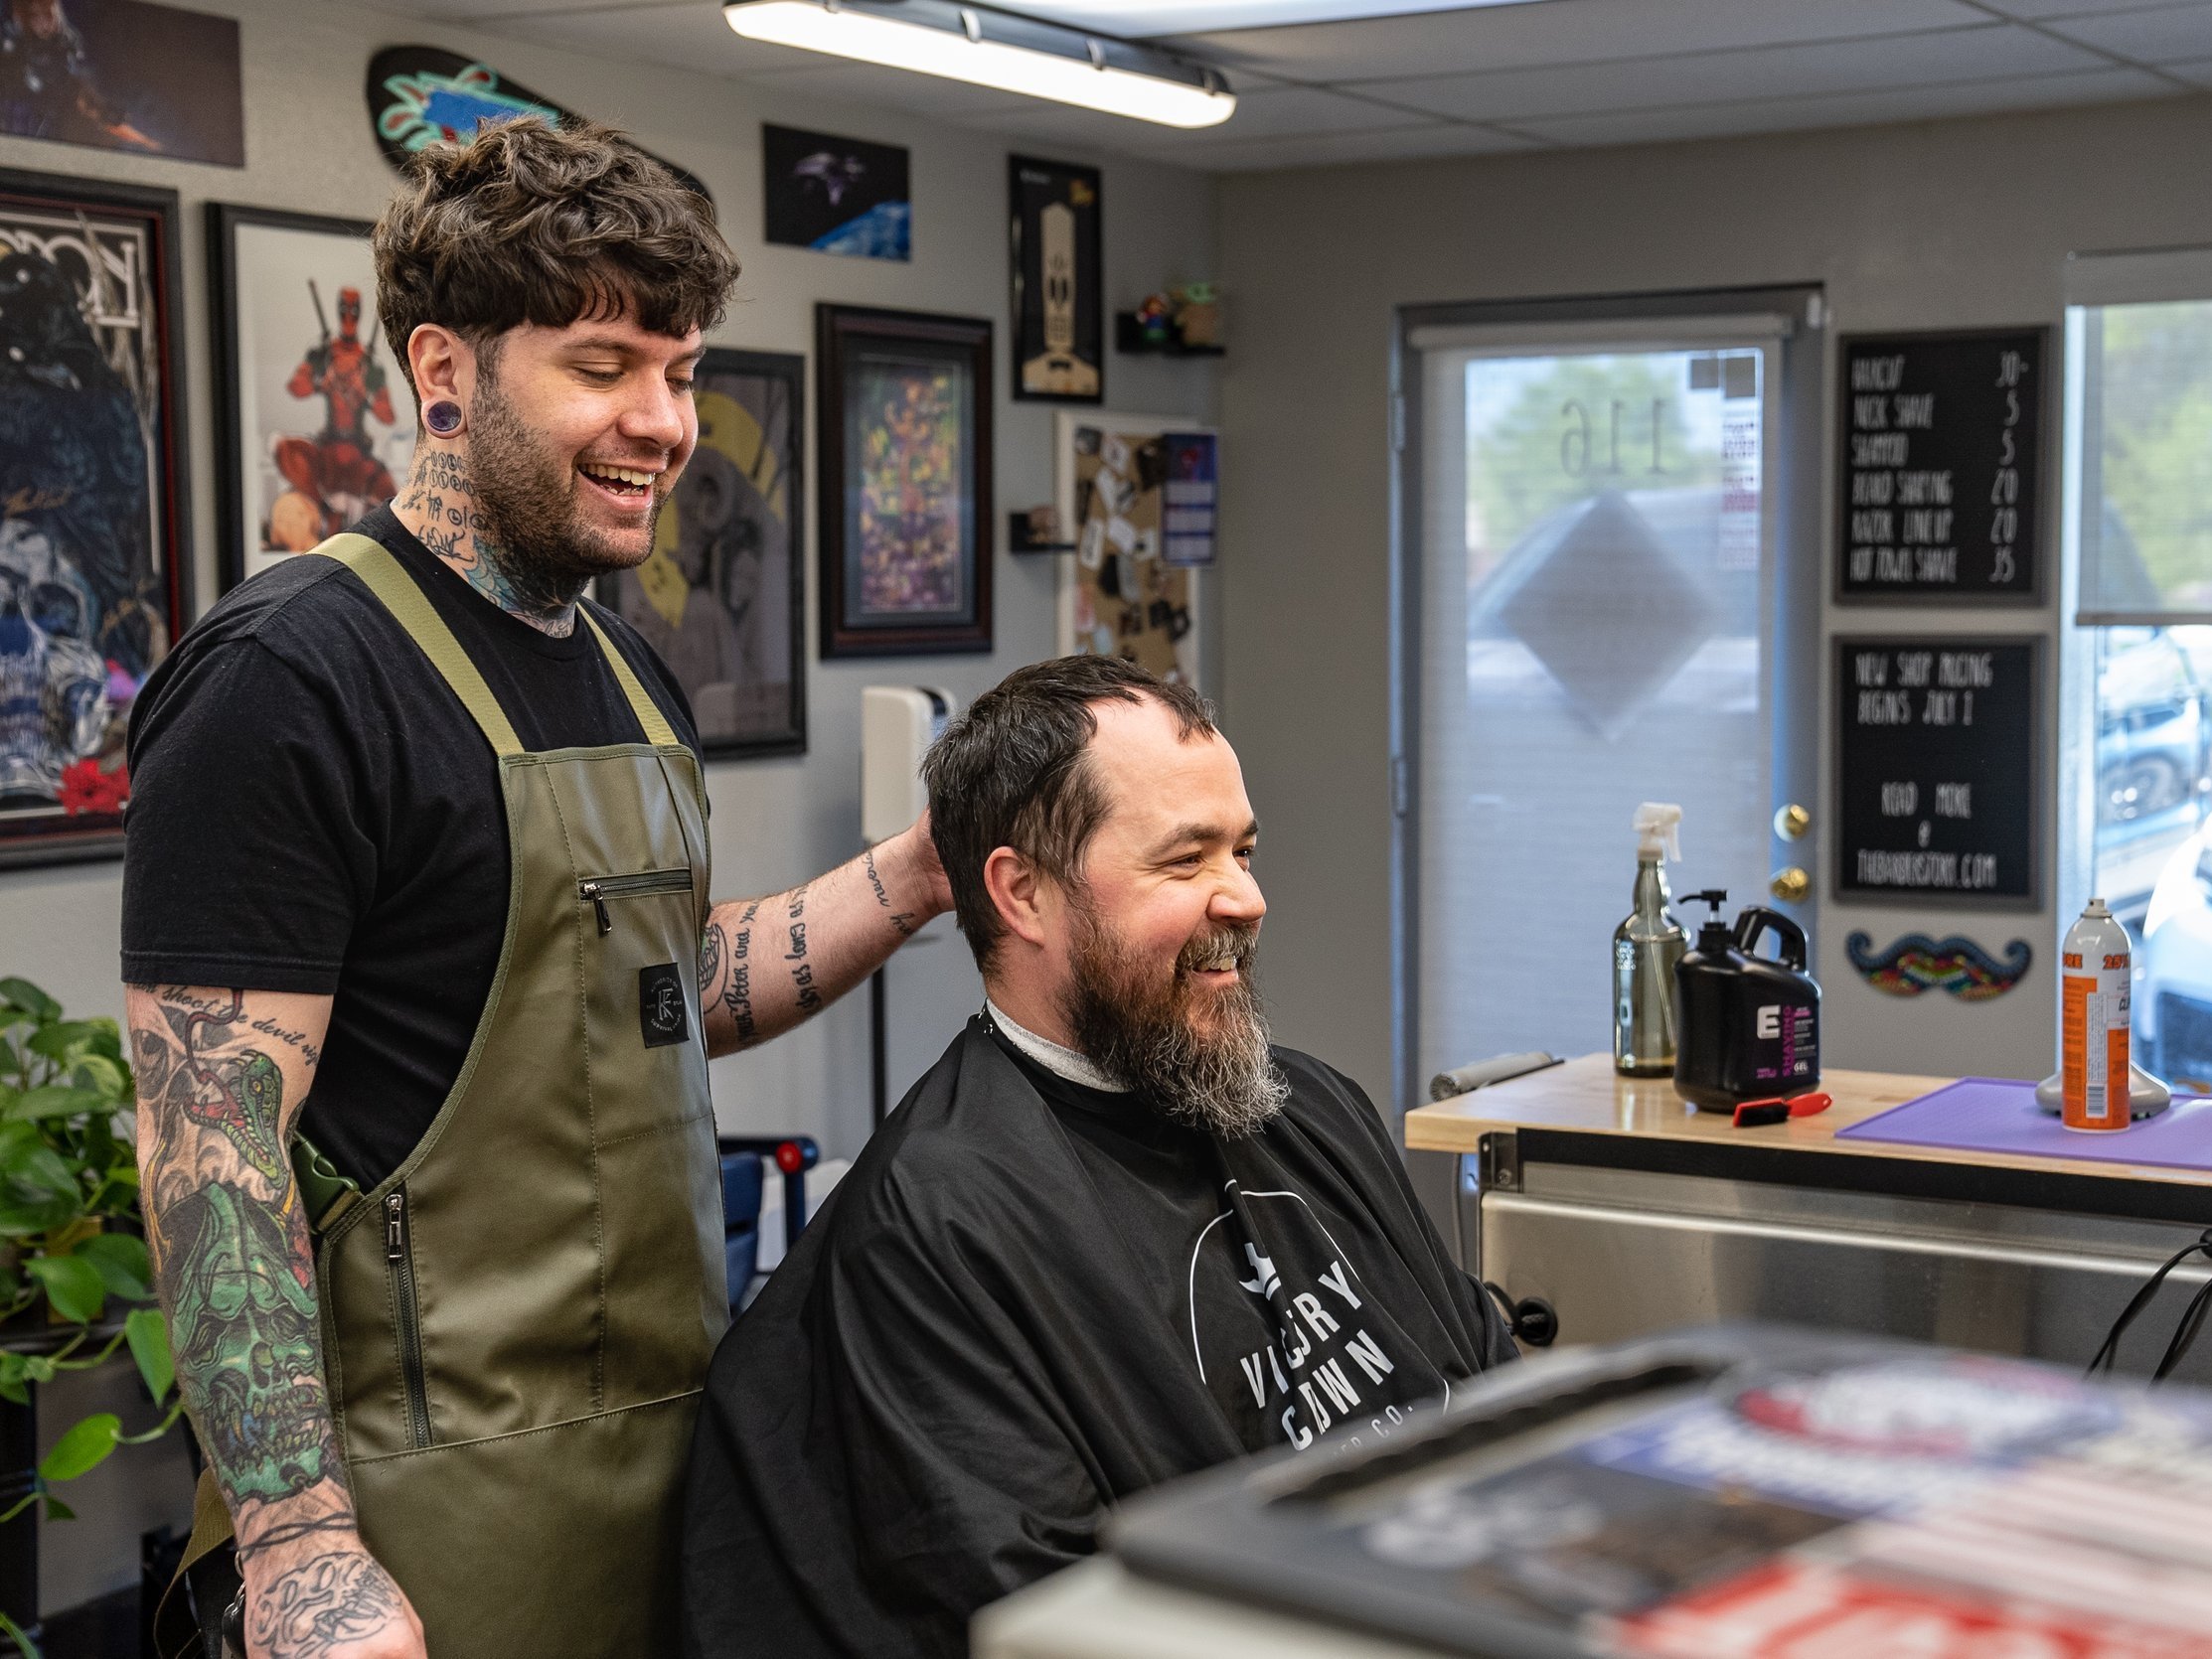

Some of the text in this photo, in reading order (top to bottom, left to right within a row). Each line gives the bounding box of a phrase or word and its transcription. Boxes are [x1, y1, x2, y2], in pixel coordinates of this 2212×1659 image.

[1853, 389, 2019, 429] NECK SHAVE 5
[1999, 428, 2015, 465] 5
[1991, 468, 2018, 505] 20
[1990, 507, 2017, 543] 20
[1855, 652, 1993, 688] NEW SHOP PRICING
[1857, 689, 1974, 725] BEGINS JULY 1
[1881, 782, 1972, 819] READ MORE
[222, 1000, 247, 1024] te
[251, 1018, 306, 1046] devil
